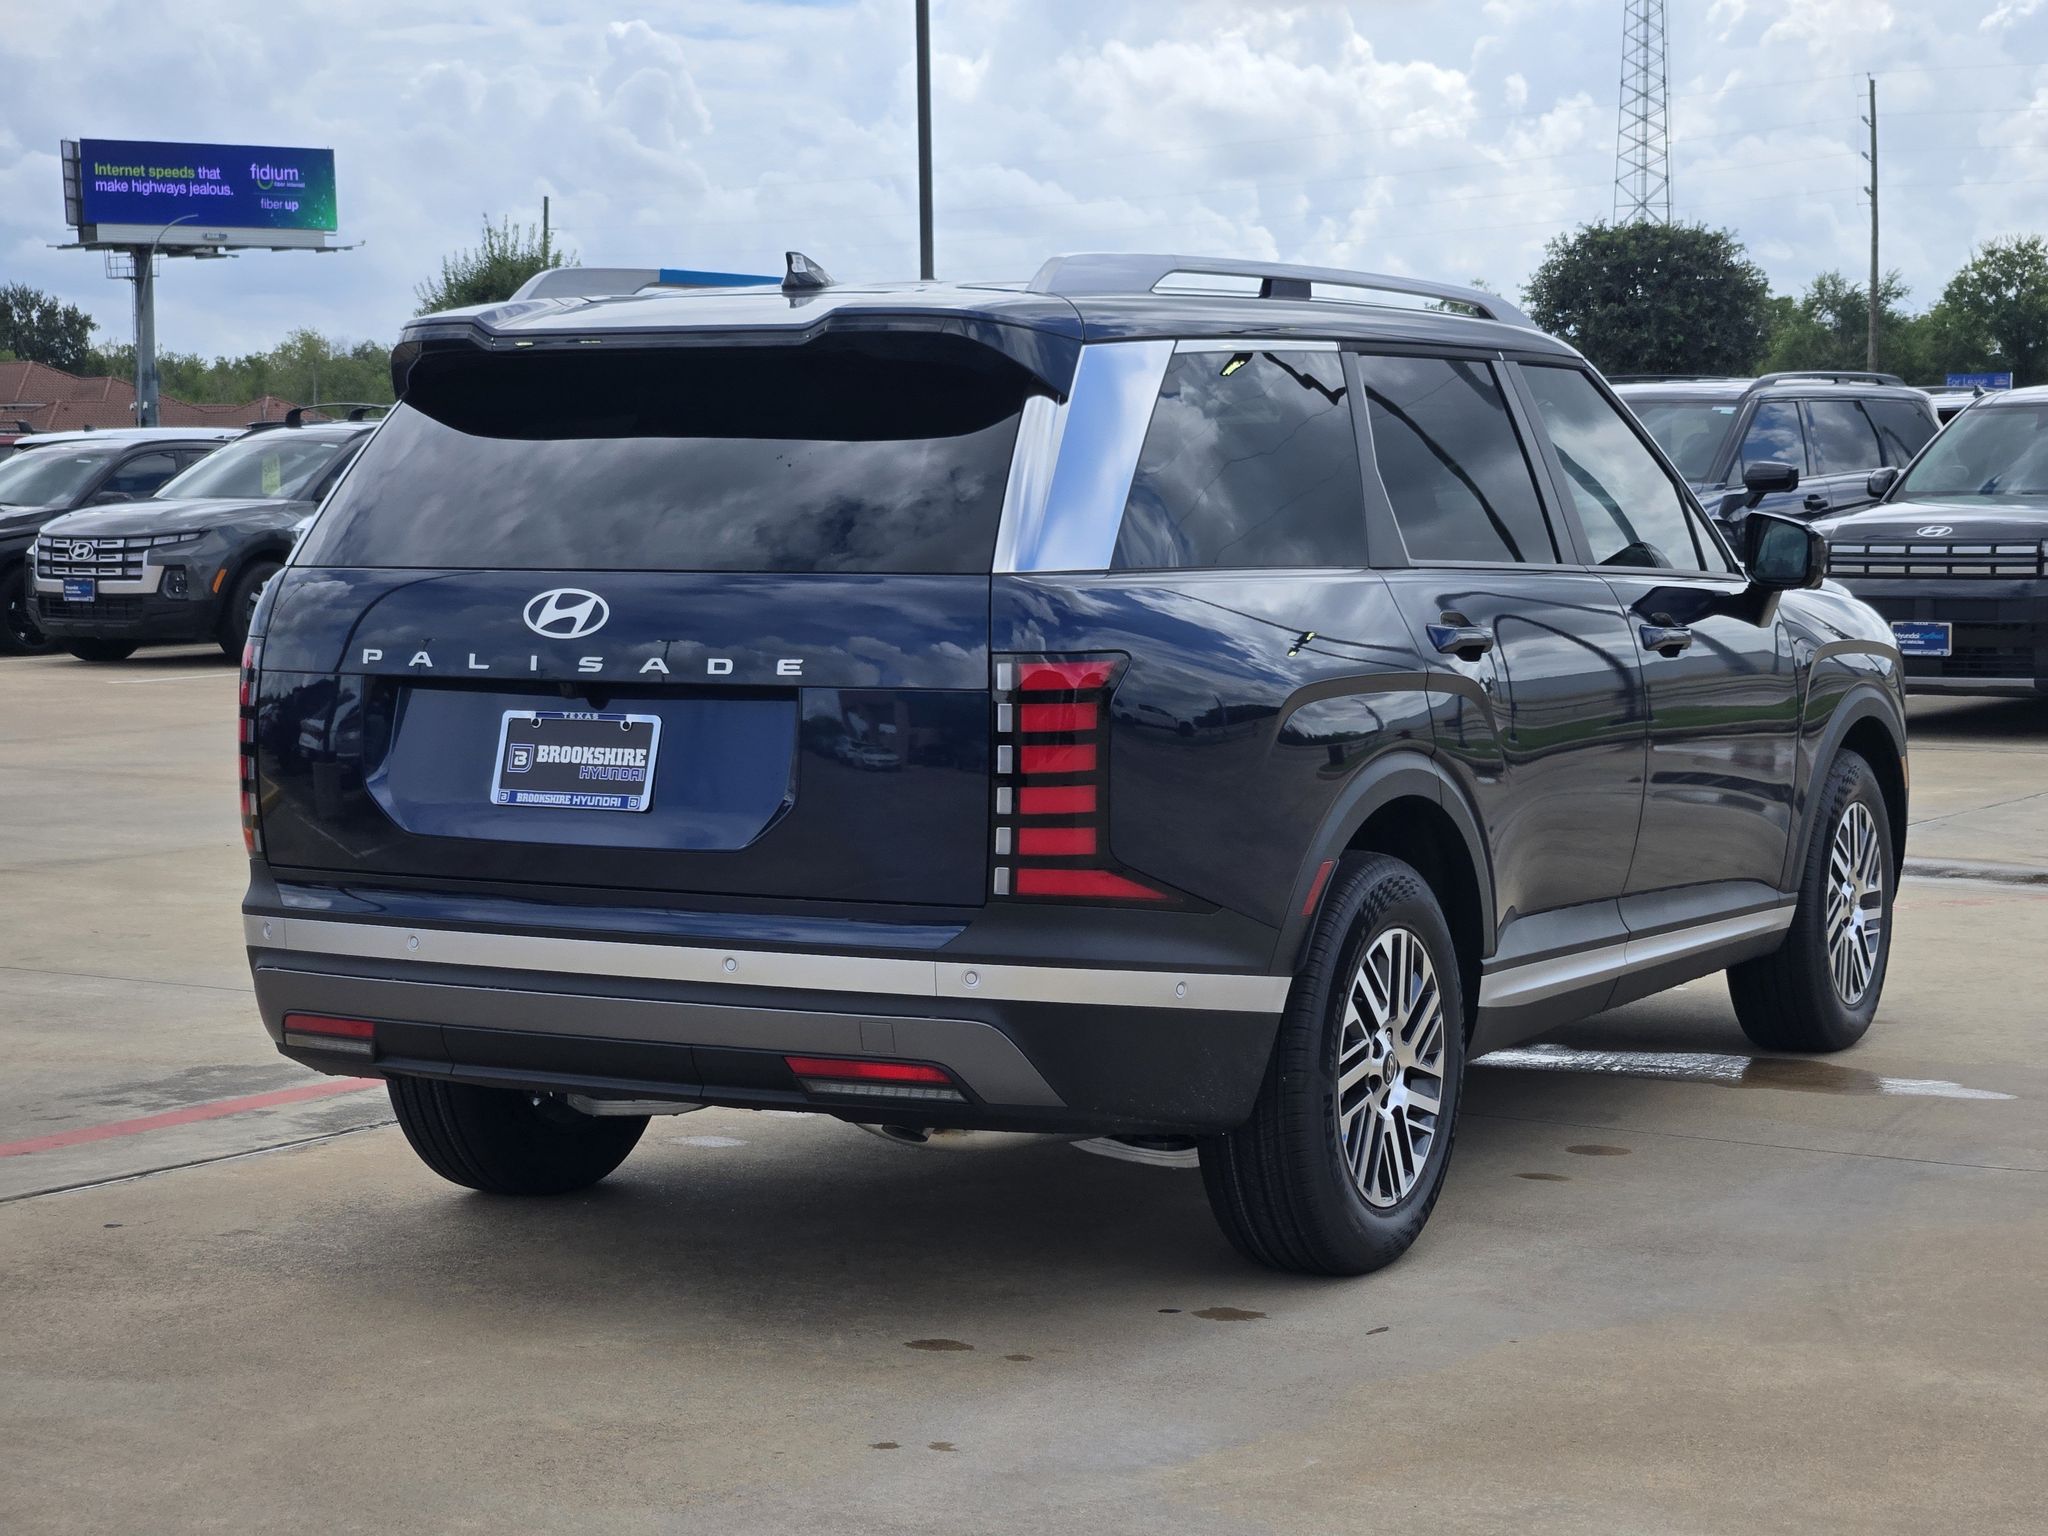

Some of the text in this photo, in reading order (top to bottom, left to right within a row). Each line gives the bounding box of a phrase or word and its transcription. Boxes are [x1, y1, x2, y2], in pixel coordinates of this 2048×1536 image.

[94, 162, 221, 180] Internet speeds that
[250, 163, 299, 181] fidium
[95, 179, 234, 197] make highways jealous.
[260, 198, 299, 212] fiber up
[361, 648, 804, 677] PALISADE
[562, 712, 599, 720] TEXAS
[536, 744, 648, 767] BROOKSHIRE
[579, 766, 646, 782] HYUNDAI
[516, 792, 622, 807] BROOKSHIRE HYUNDAI
